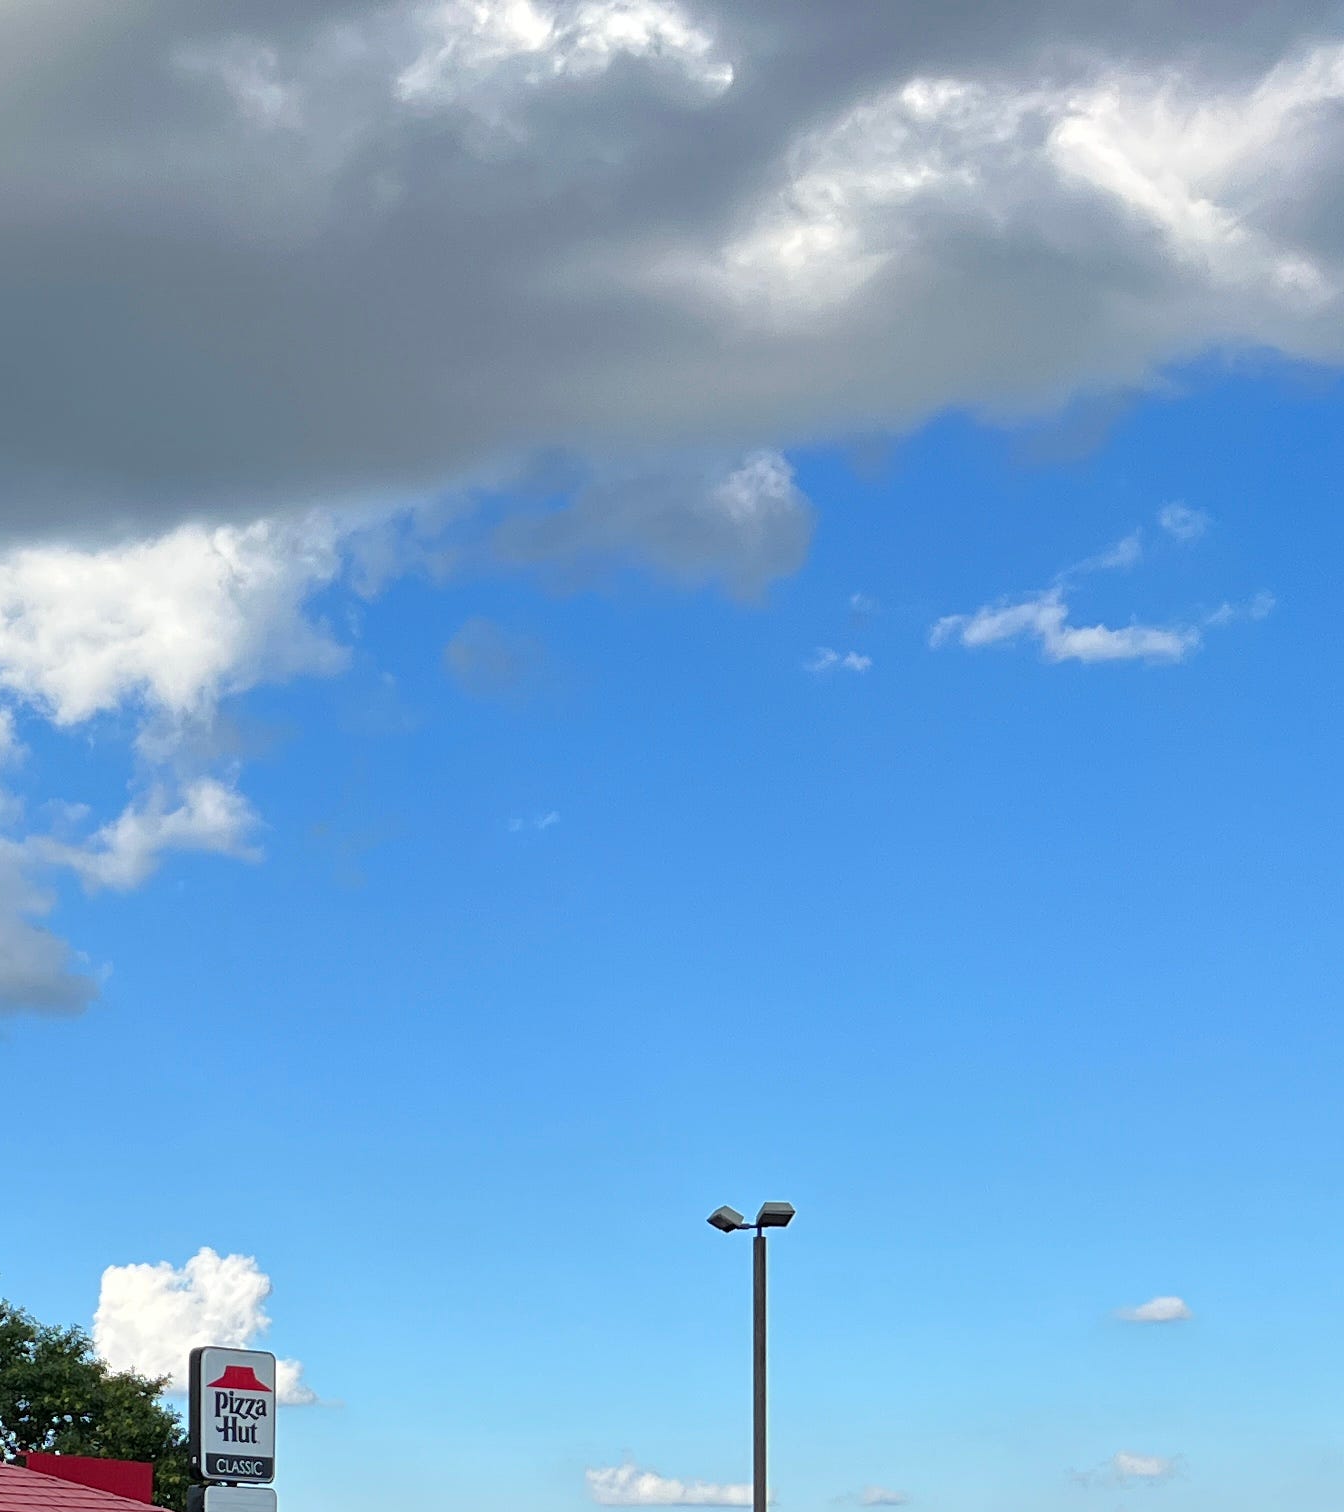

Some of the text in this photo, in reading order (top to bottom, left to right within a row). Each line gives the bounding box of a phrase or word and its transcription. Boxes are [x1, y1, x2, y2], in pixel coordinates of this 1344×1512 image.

[214, 1390, 267, 1420] Pizza
[216, 1415, 258, 1444] Hut
[216, 1458, 263, 1476] CLASSIC
